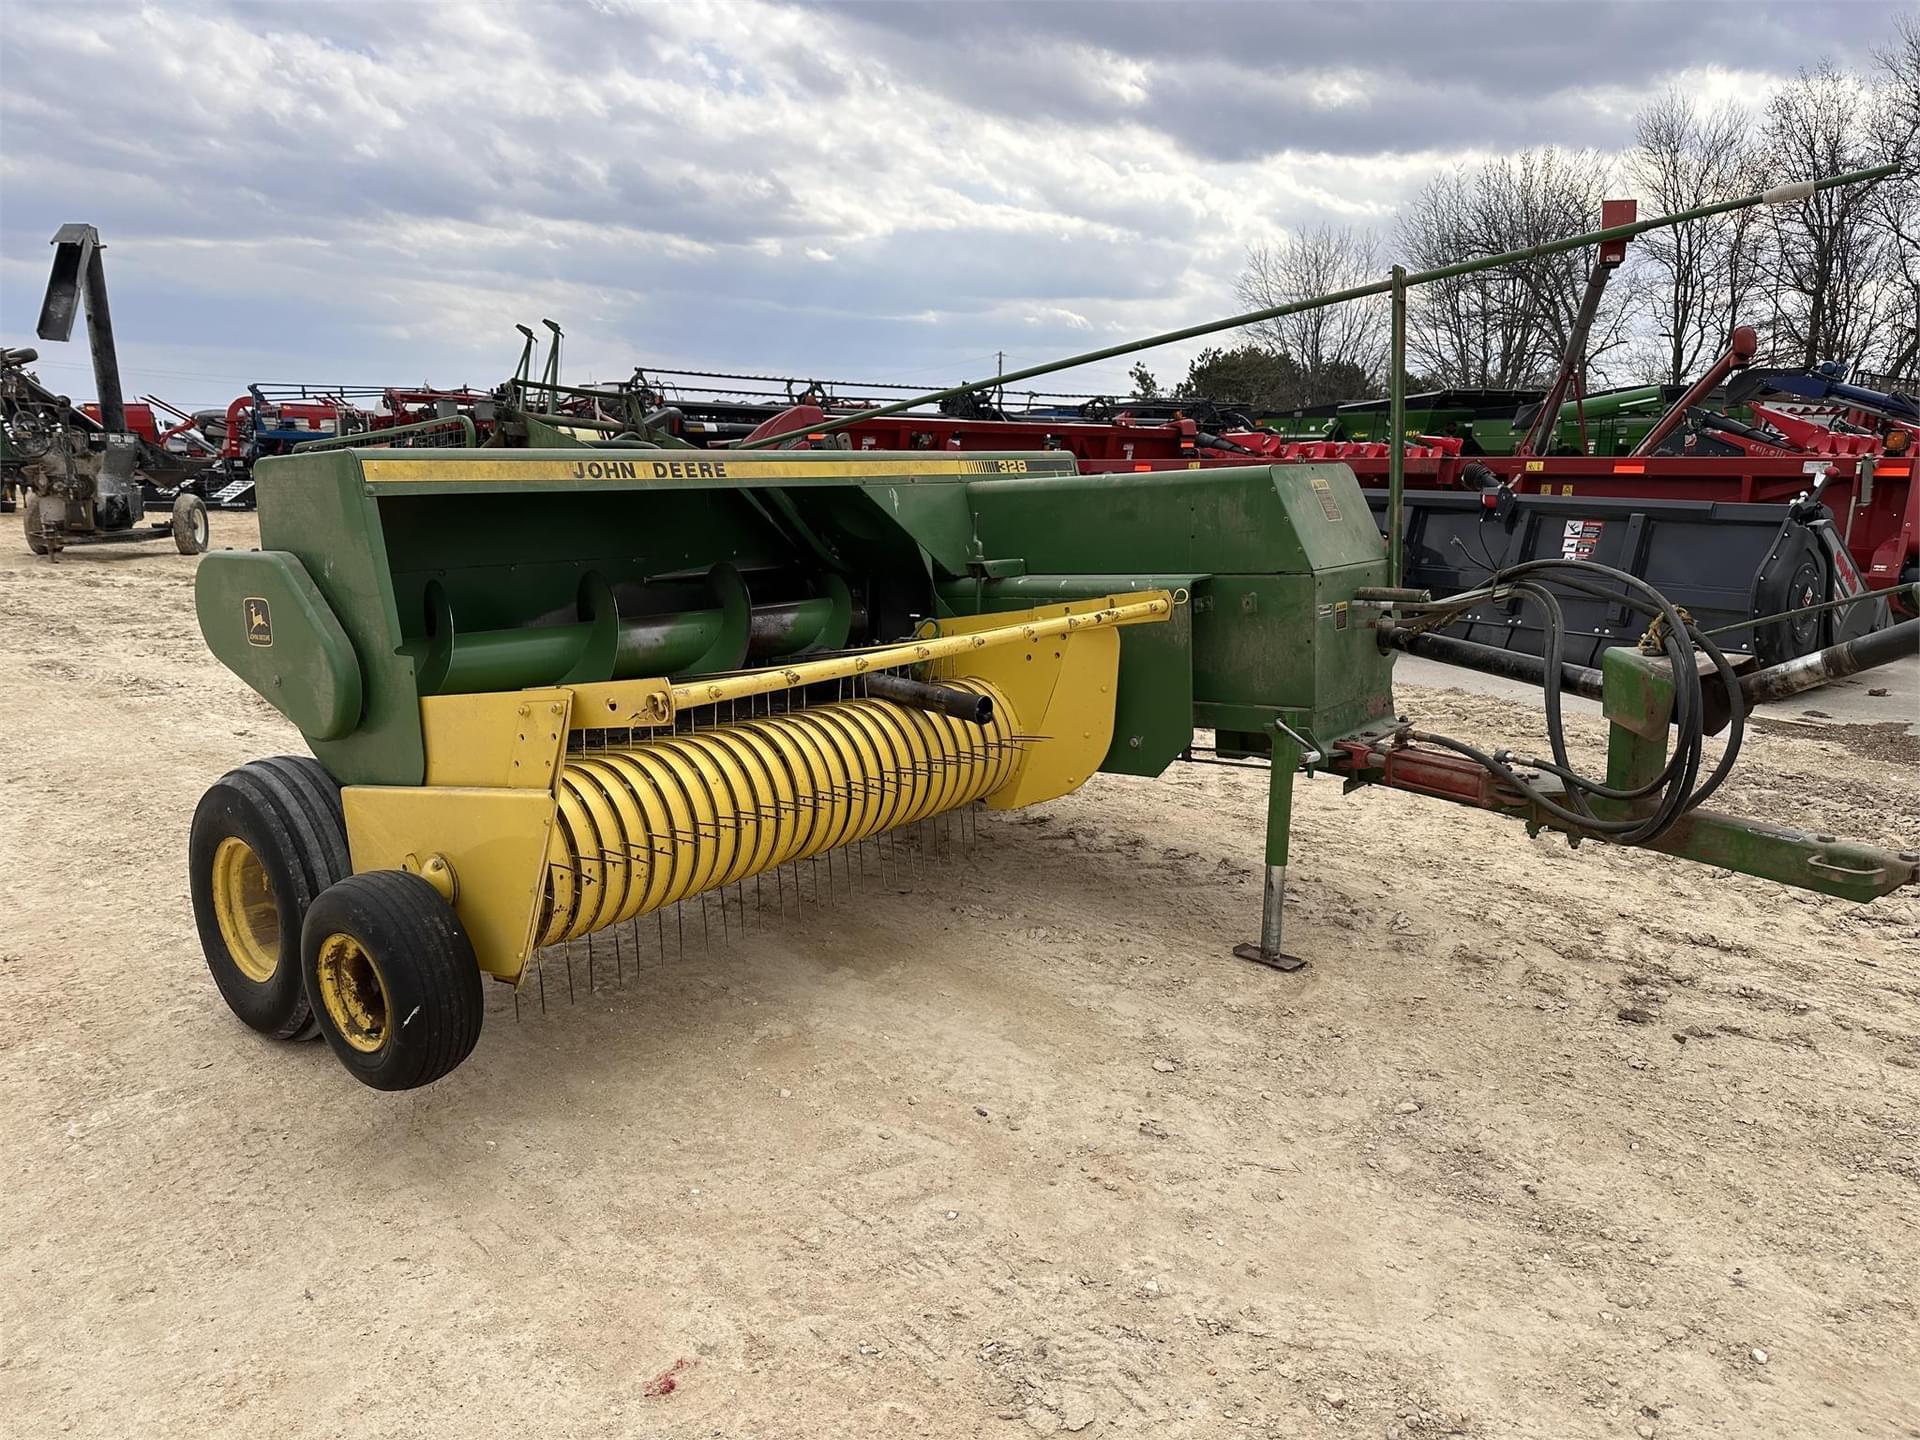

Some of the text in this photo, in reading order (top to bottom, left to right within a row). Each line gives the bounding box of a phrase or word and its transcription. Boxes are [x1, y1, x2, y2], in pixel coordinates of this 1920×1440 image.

[573, 461, 727, 479] JOHN DEERE
[998, 460, 1028, 473] 328
